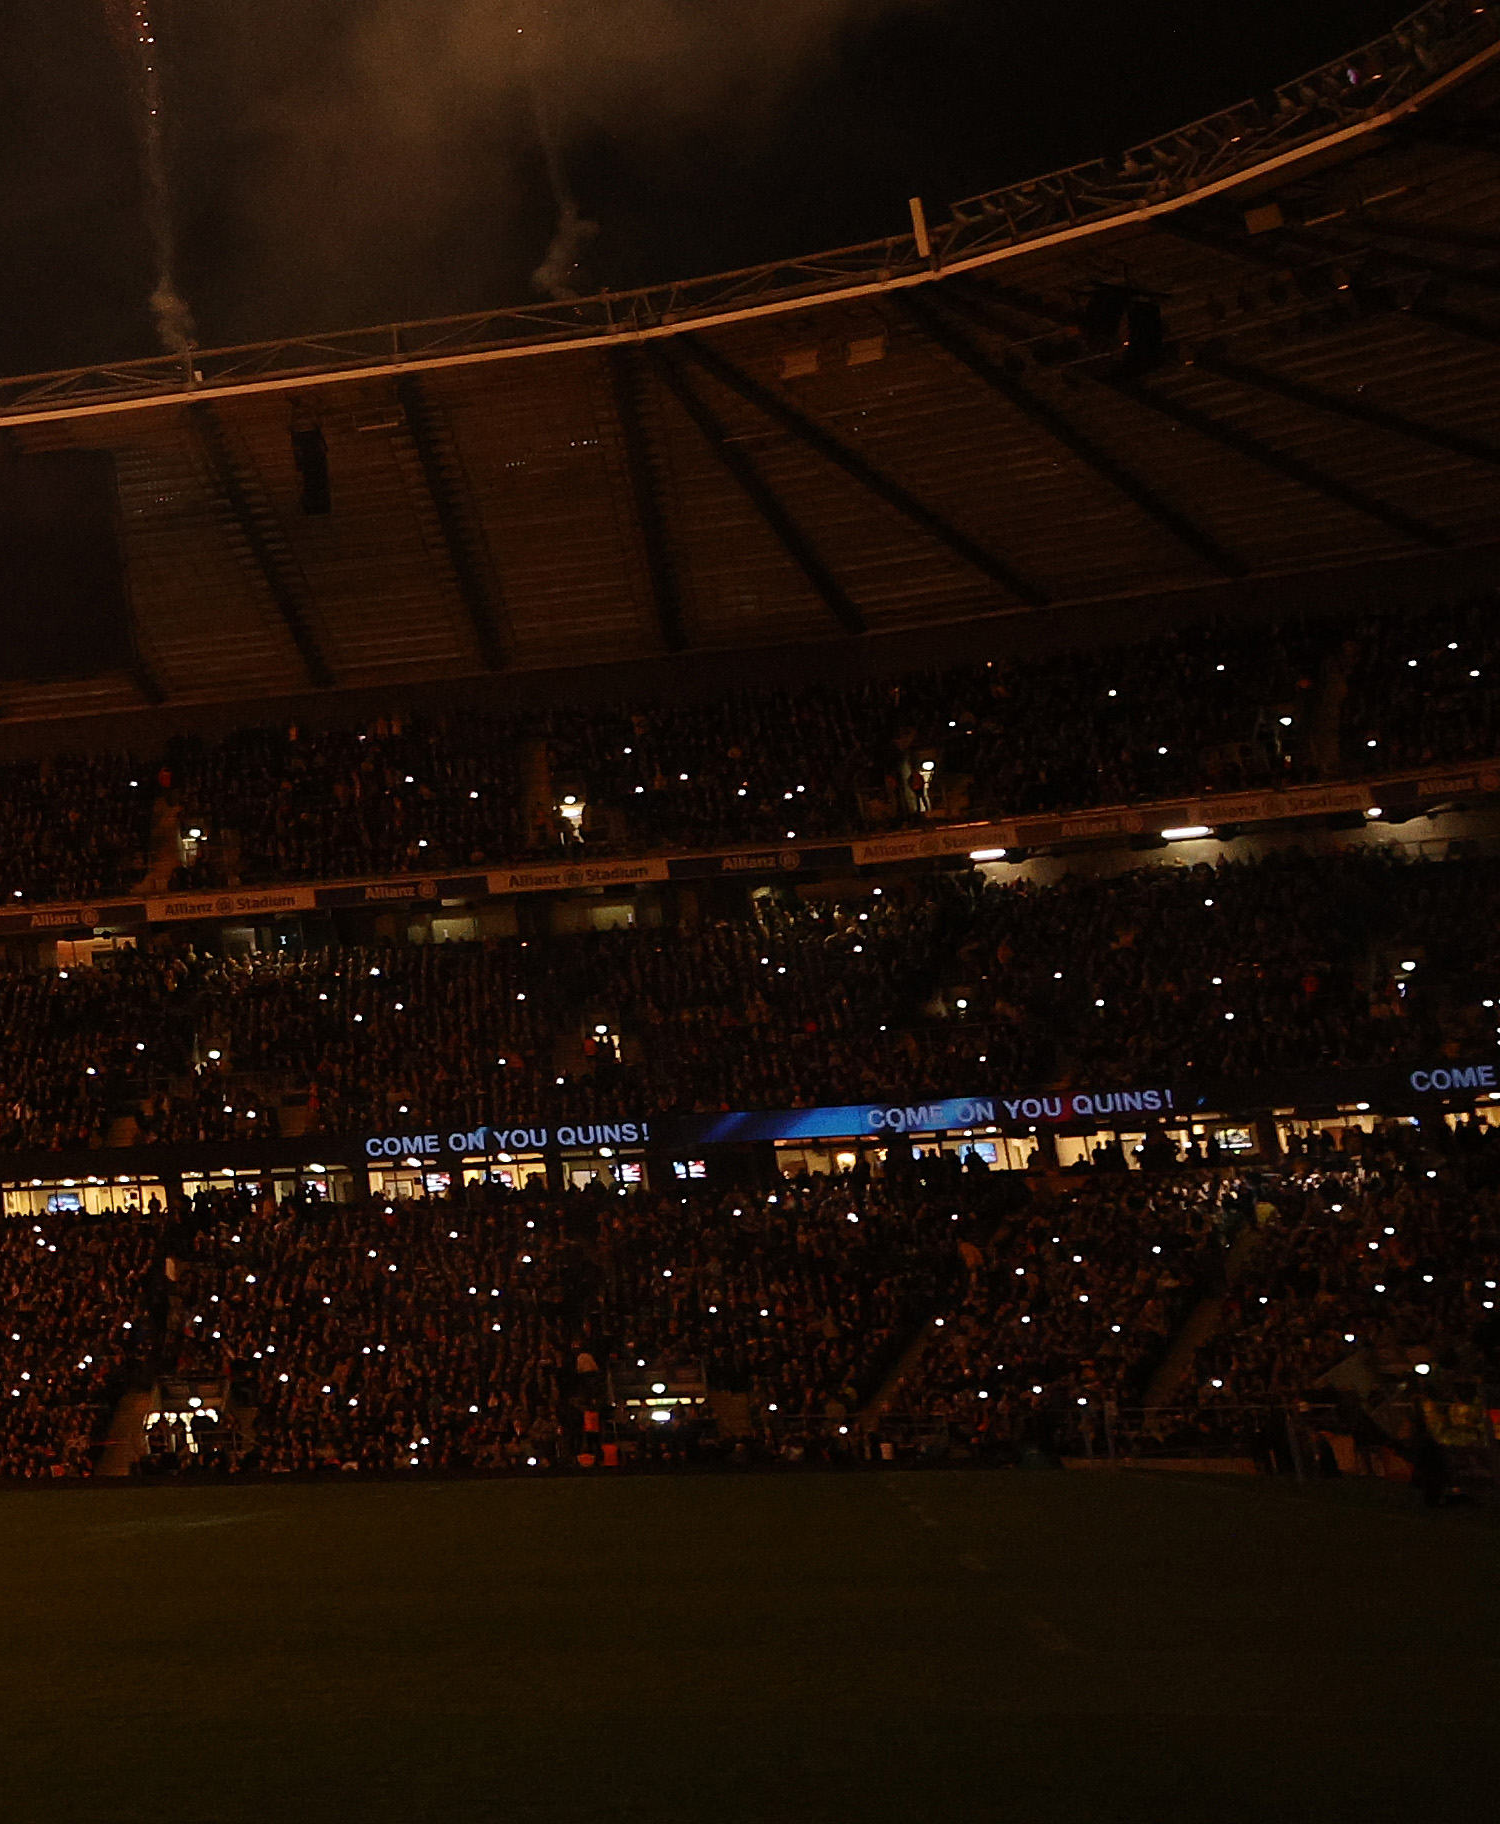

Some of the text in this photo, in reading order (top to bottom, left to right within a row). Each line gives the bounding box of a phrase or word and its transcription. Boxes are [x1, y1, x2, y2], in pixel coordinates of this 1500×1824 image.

[364, 886, 416, 900] Allianz
[164, 895, 295, 916] Allianz Stadium
[30, 913, 79, 926] Allianz
[1409, 1065, 1497, 1092] COME
[866, 1088, 1174, 1133] COME ON YOU QUINS!
[365, 1122, 650, 1157] COME ON YOU QUINS!
